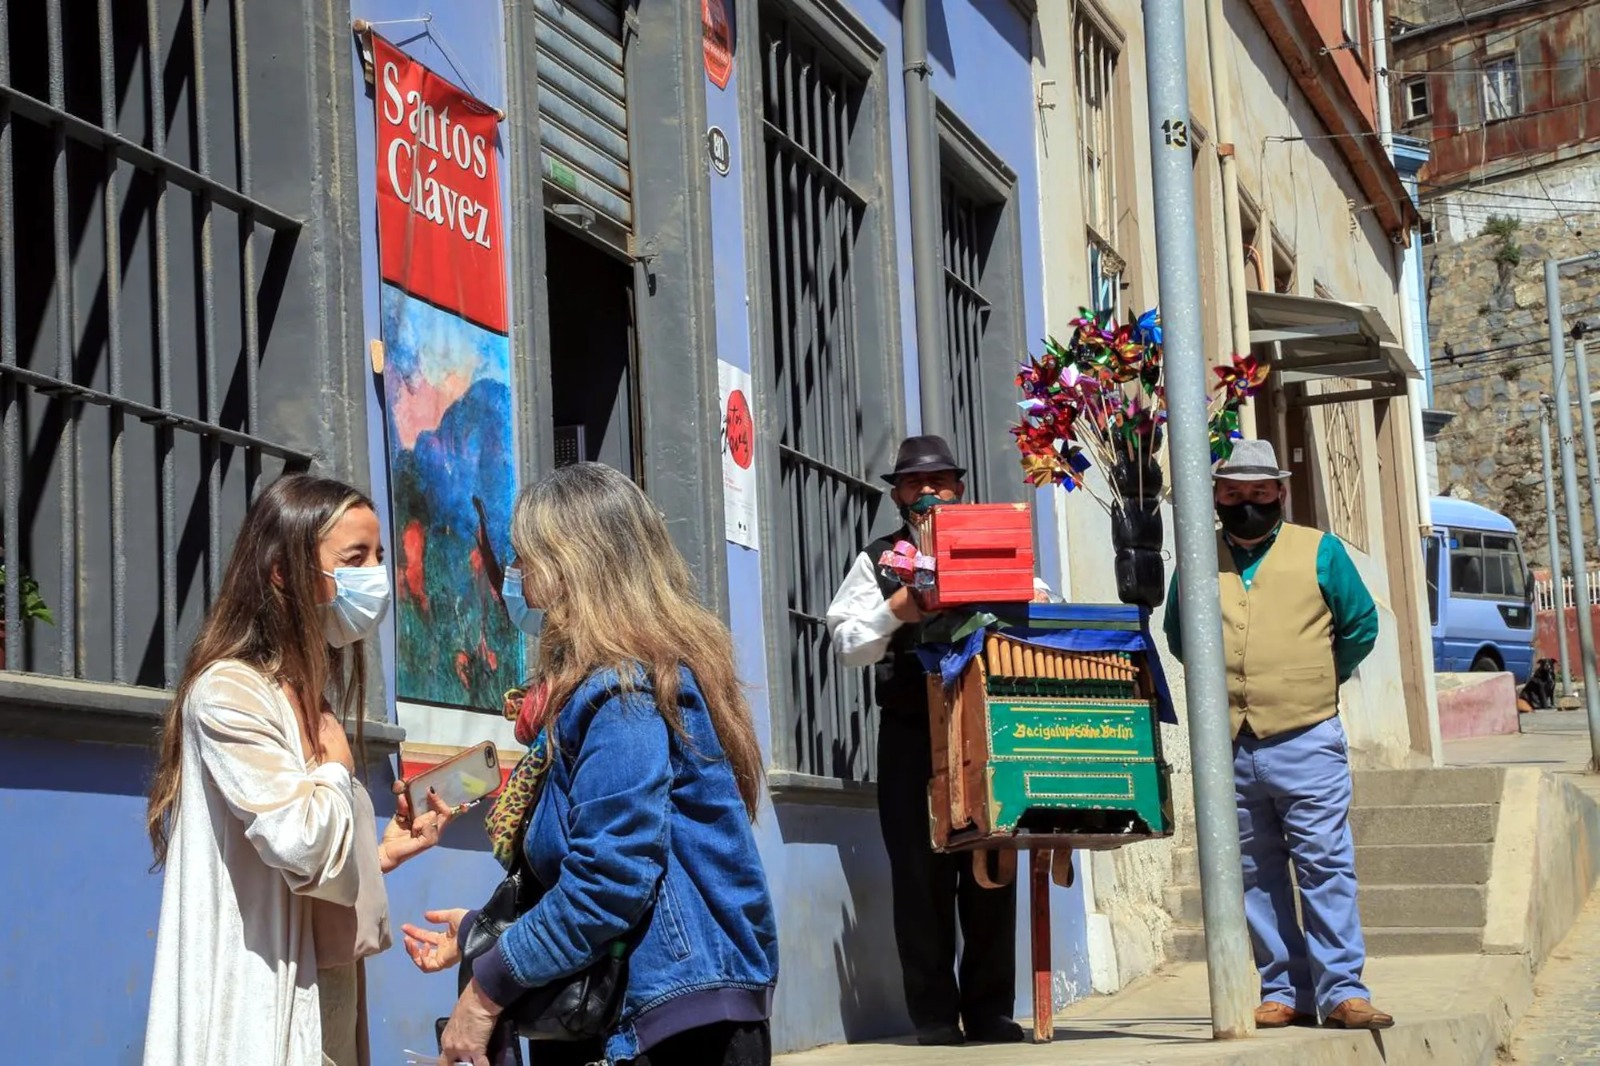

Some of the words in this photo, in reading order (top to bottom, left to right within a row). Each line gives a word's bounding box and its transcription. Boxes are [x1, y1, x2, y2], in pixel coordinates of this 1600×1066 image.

[383, 61, 487, 179] Santos
[1161, 119, 1188, 147] 13
[387, 137, 492, 249] Chávez
